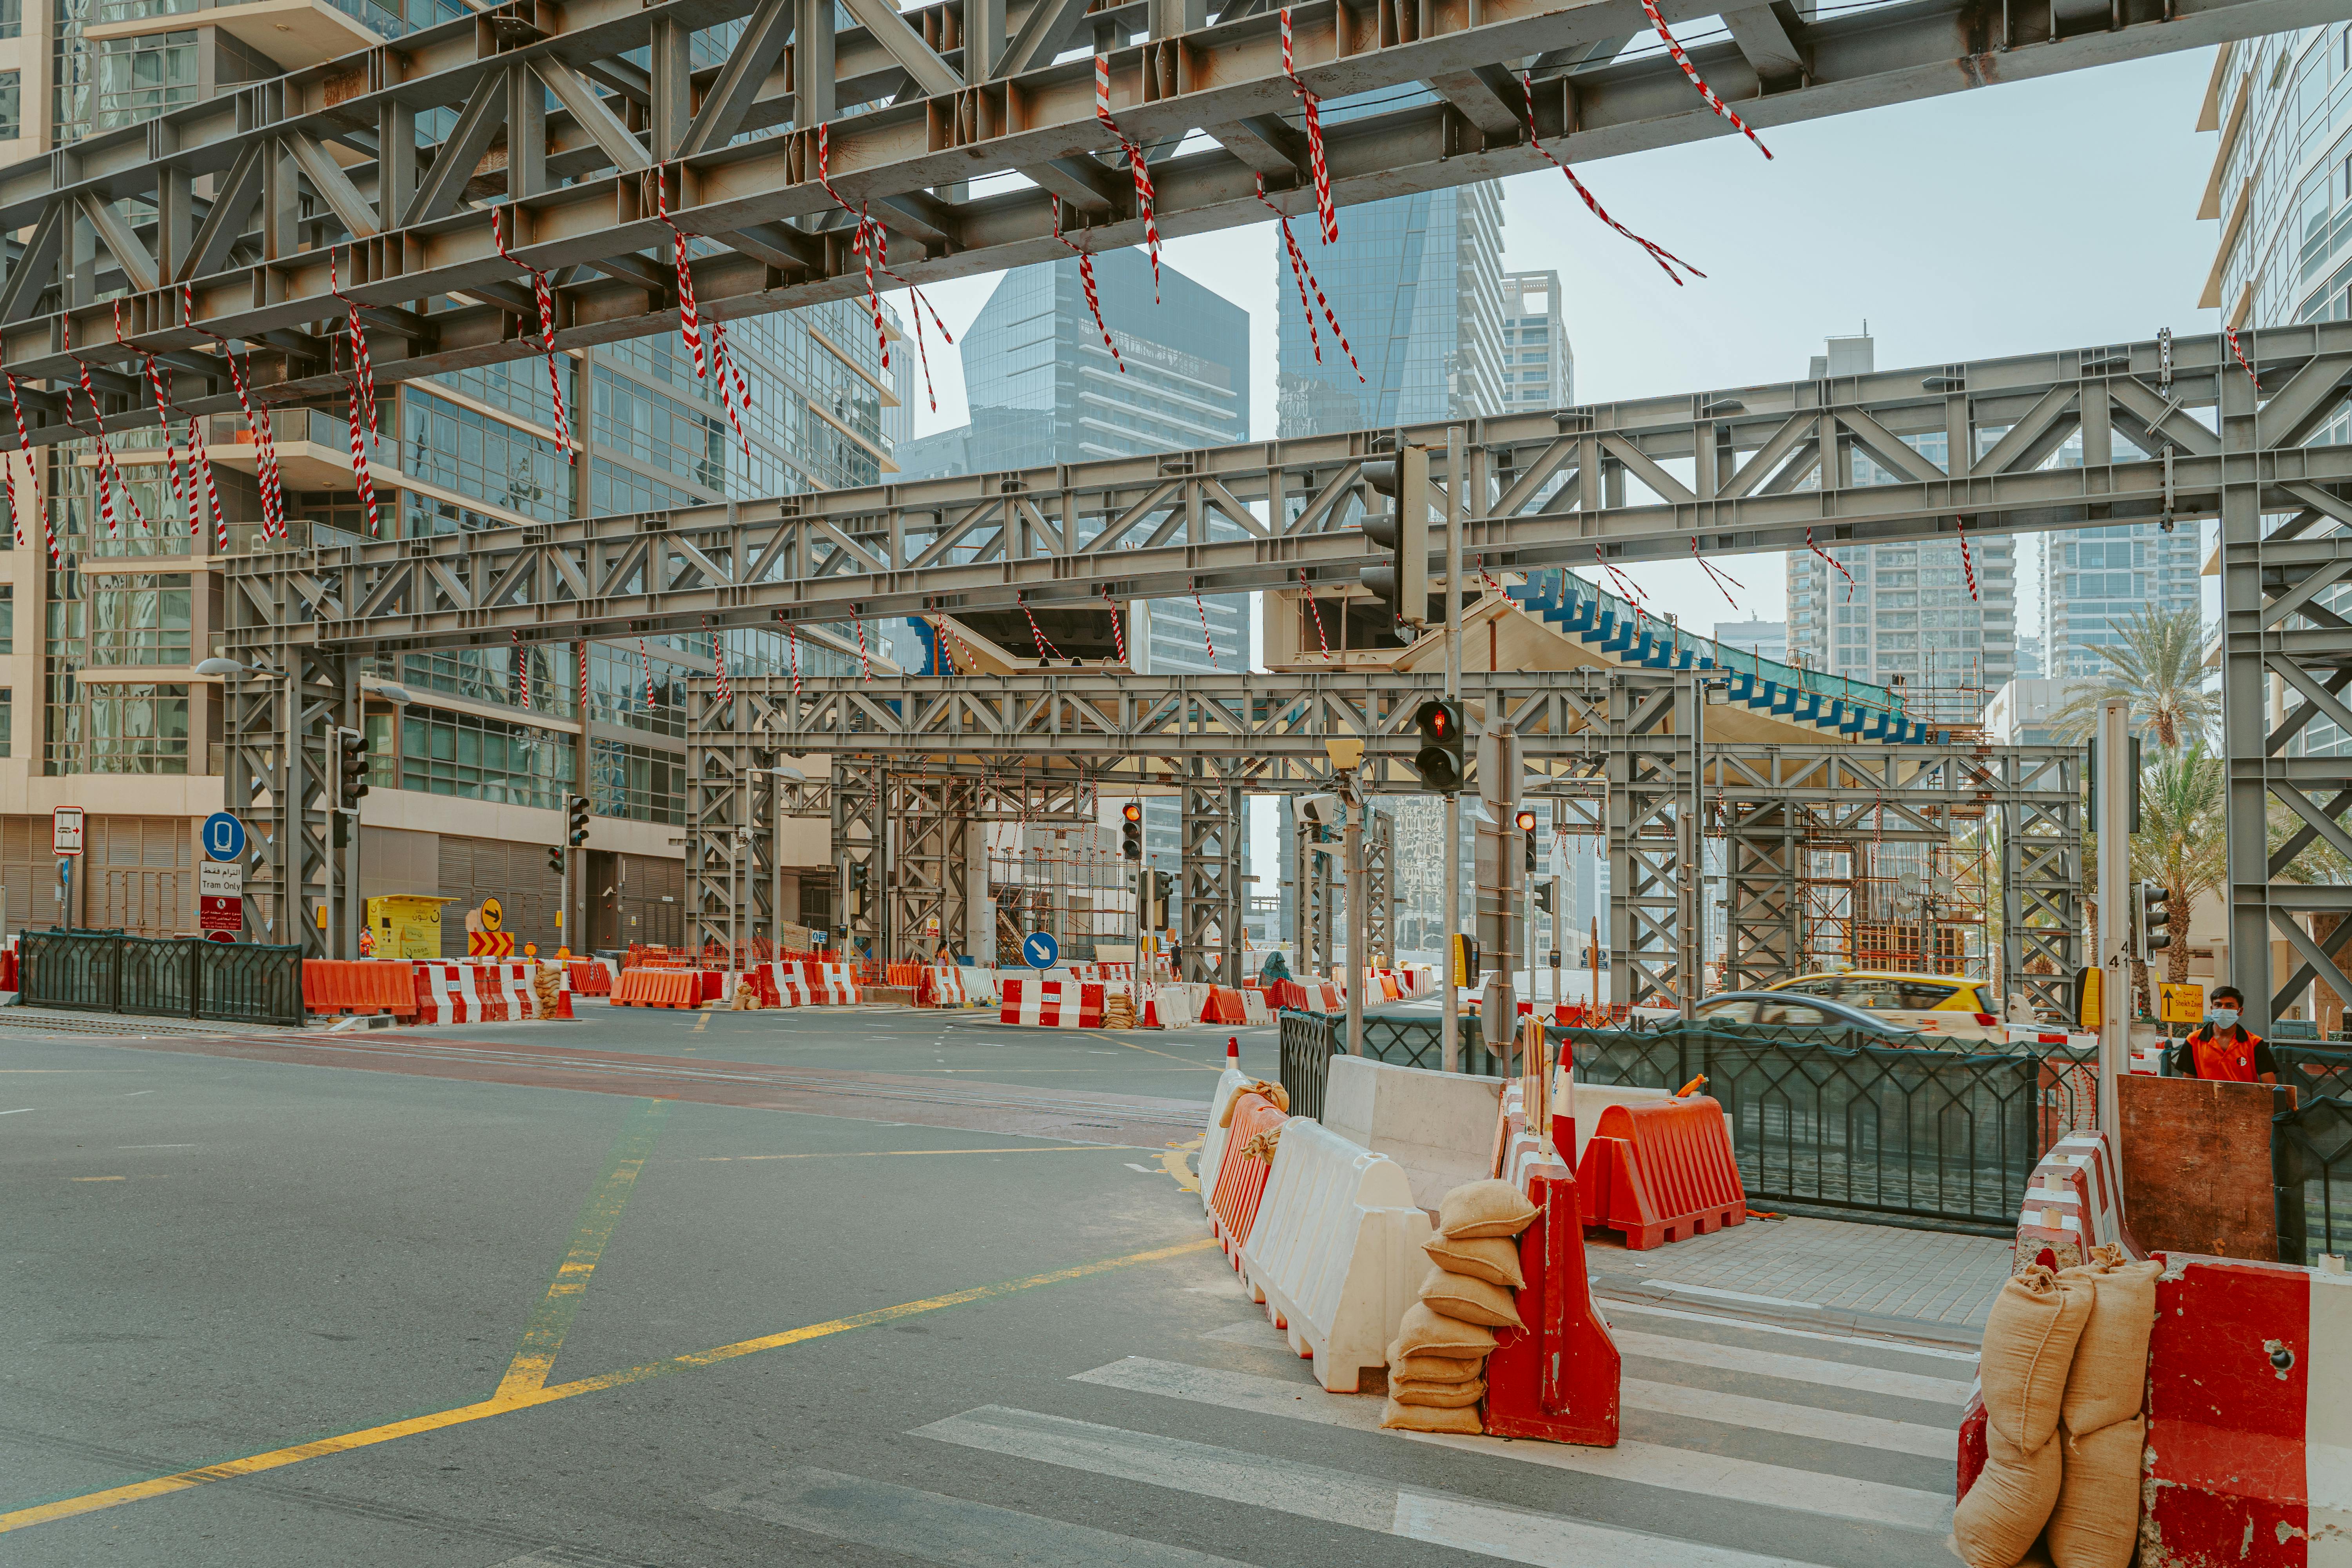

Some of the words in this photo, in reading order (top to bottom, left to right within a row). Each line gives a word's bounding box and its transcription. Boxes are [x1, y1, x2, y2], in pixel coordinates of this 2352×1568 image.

[903, 443, 916, 452] PLAZA
[222, 869, 240, 878] الترام
[224, 882, 240, 891] Only
[2121, 941, 2129, 954] 4
[2109, 955, 2119, 968] 4
[2123, 957, 2128, 968] 1
